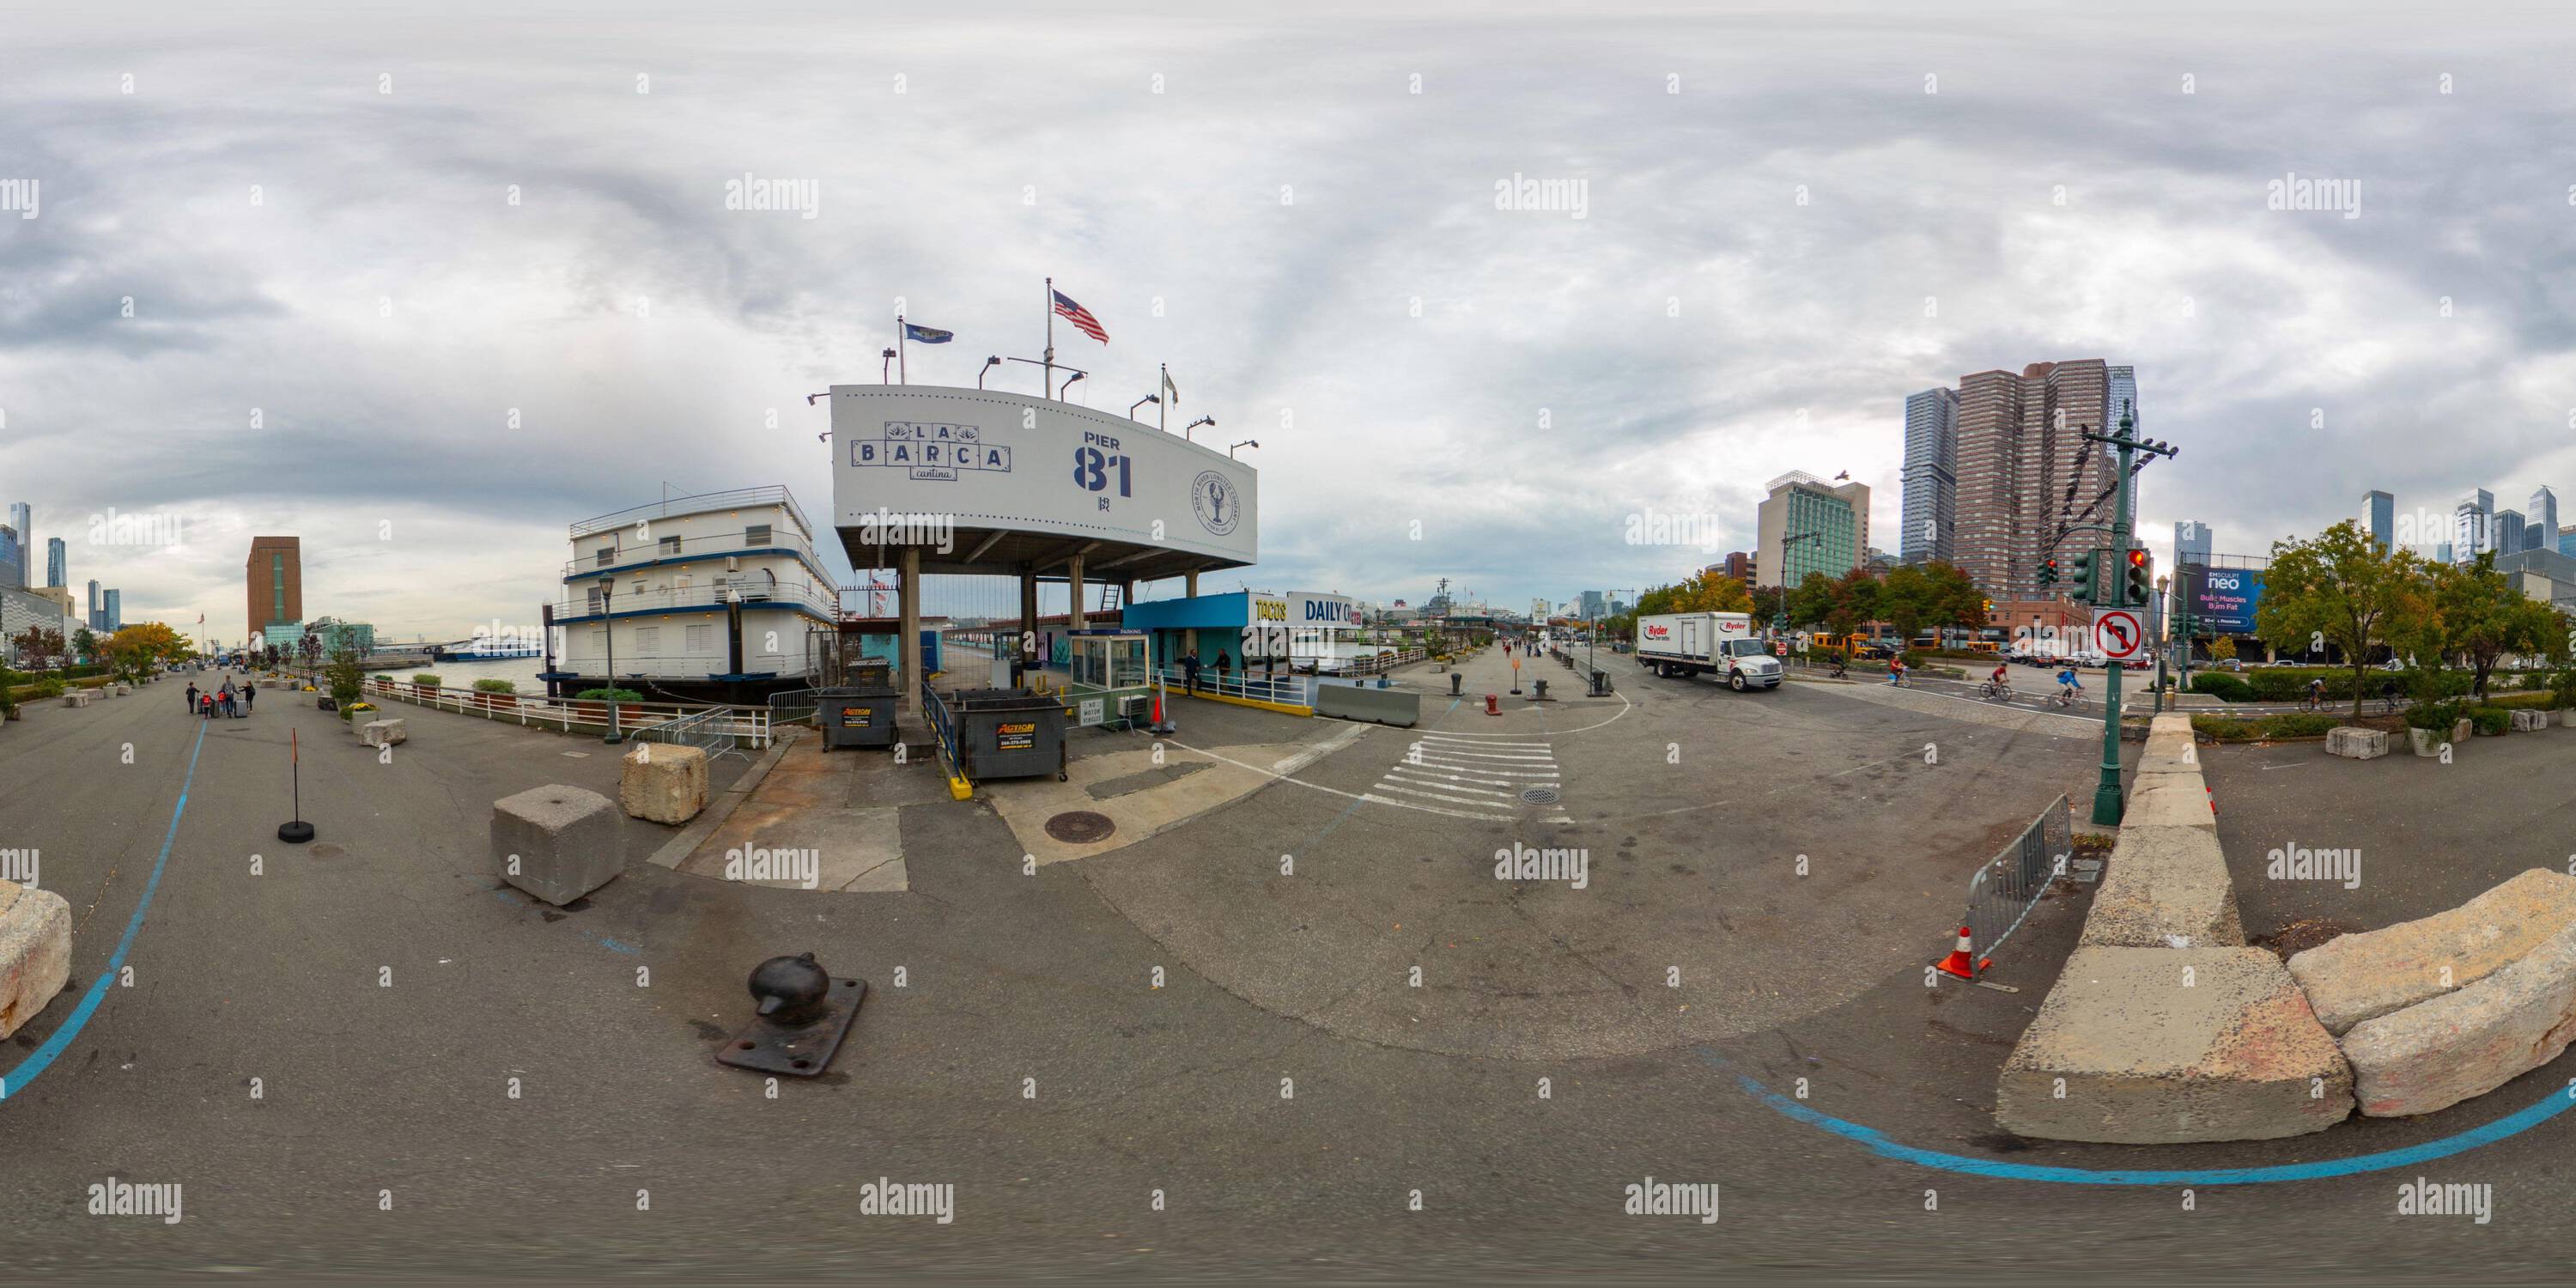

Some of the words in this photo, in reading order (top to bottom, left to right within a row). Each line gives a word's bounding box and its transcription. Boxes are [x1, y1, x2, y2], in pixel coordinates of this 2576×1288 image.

[917, 426, 949, 439] LA
[1084, 431, 1121, 451] PIER
[862, 444, 1001, 466] BARCA
[916, 468, 951, 478] cantina
[1073, 447, 1131, 498] 81
[1197, 473, 1210, 487] RIVER
[1210, 473, 1231, 490] LOBSTER
[2208, 578, 2239, 590] neo
[1255, 599, 1286, 622] TACOS
[1306, 600, 1342, 622] DAILY
[1649, 625, 1668, 636] Ryder
[1725, 622, 1746, 631] Ryder
[997, 724, 1035, 733] ACTION
